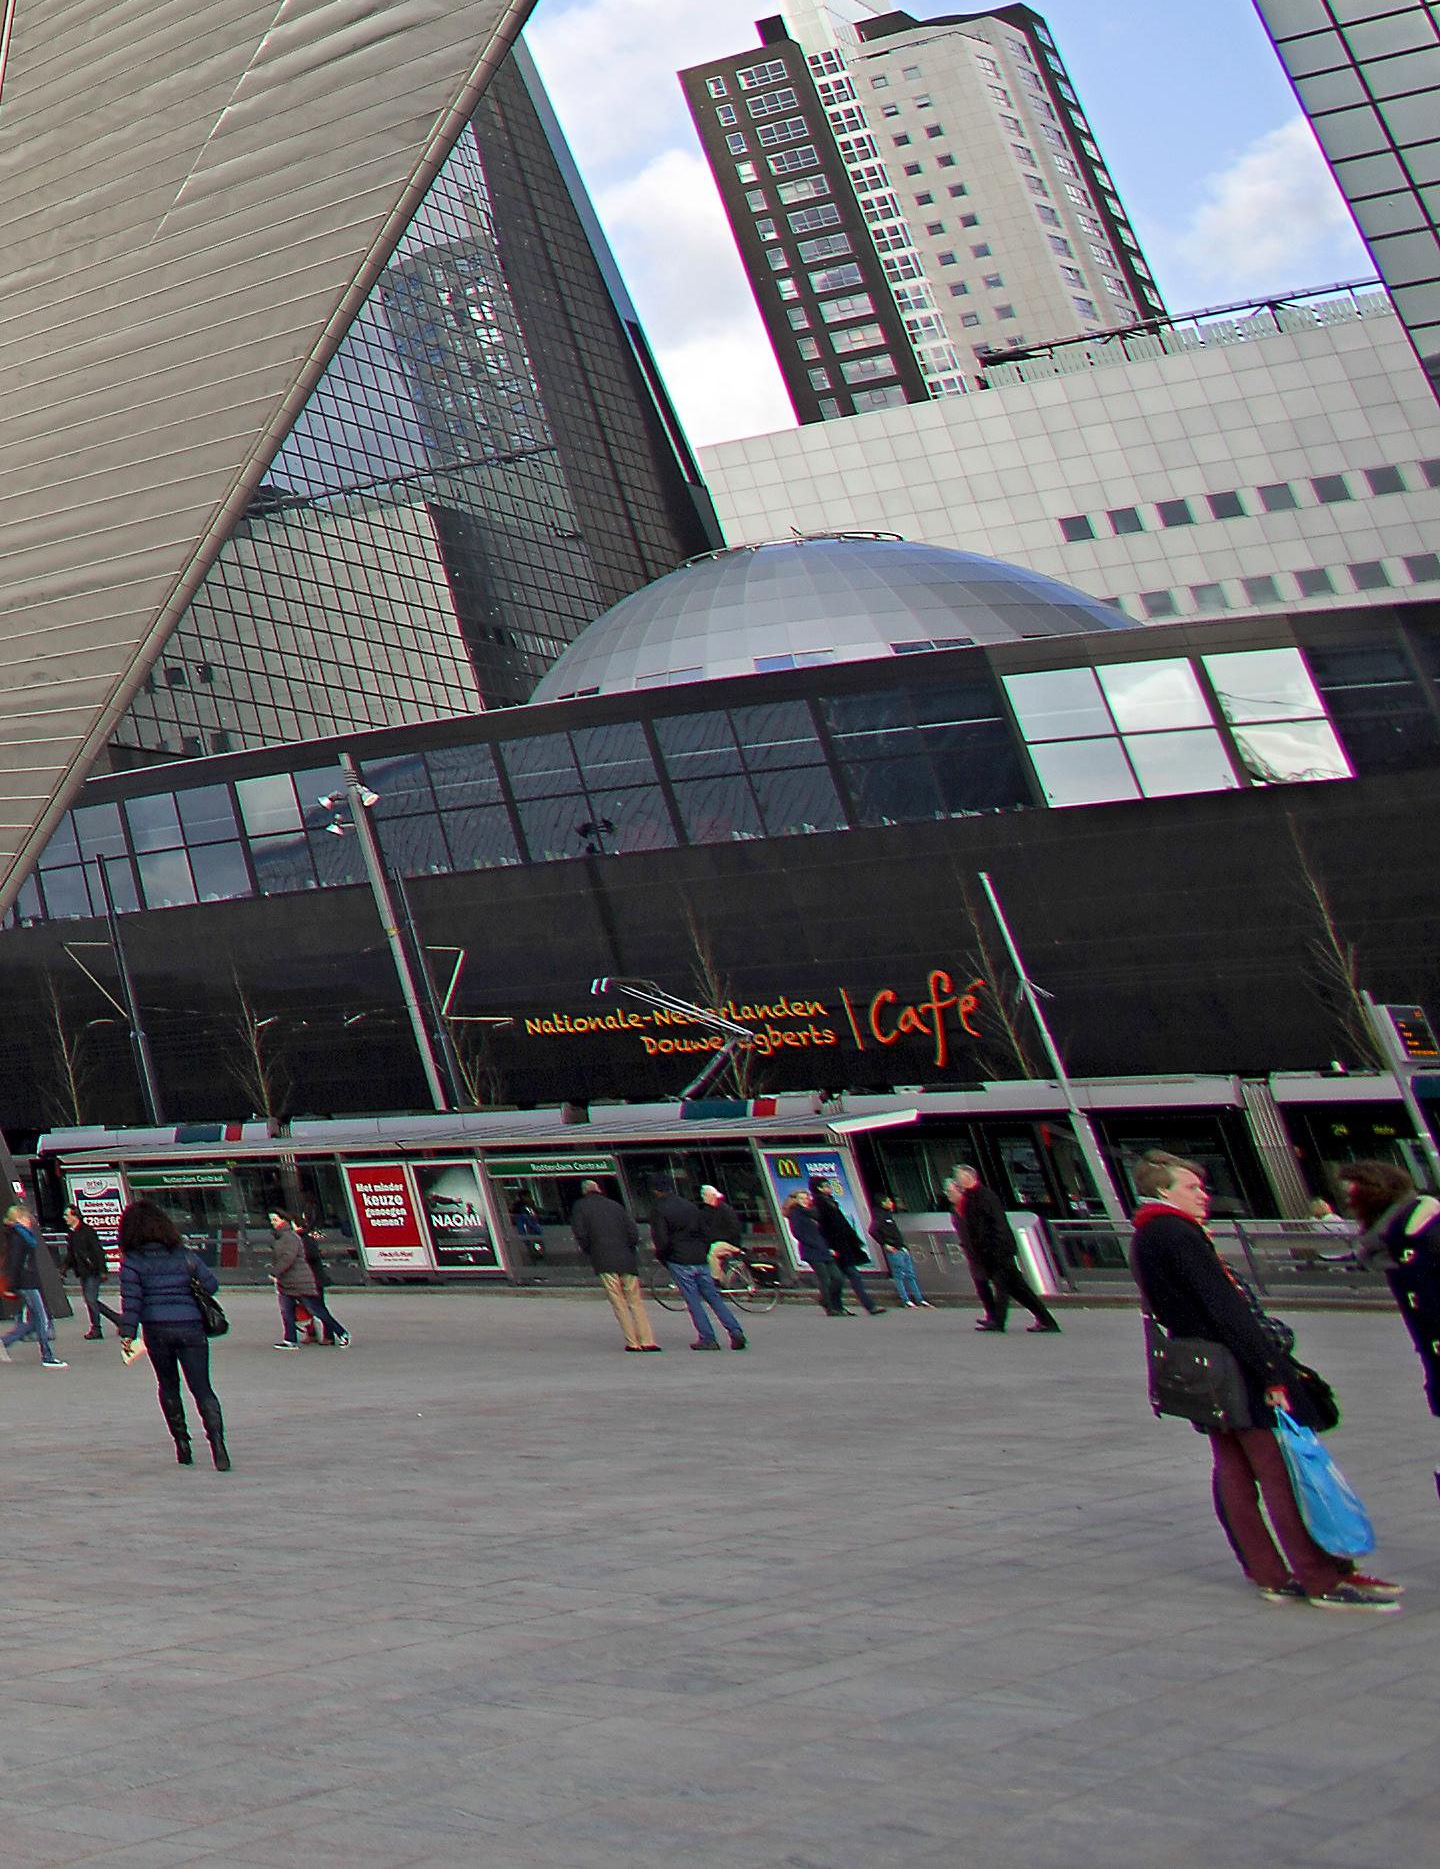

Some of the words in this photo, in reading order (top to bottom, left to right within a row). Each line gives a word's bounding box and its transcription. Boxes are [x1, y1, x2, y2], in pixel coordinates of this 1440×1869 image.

[869, 969, 987, 1067] Café
[641, 1036, 723, 1055] Douwe
[362, 1193, 403, 1207] keuze
[431, 1214, 482, 1228] NAOMI
